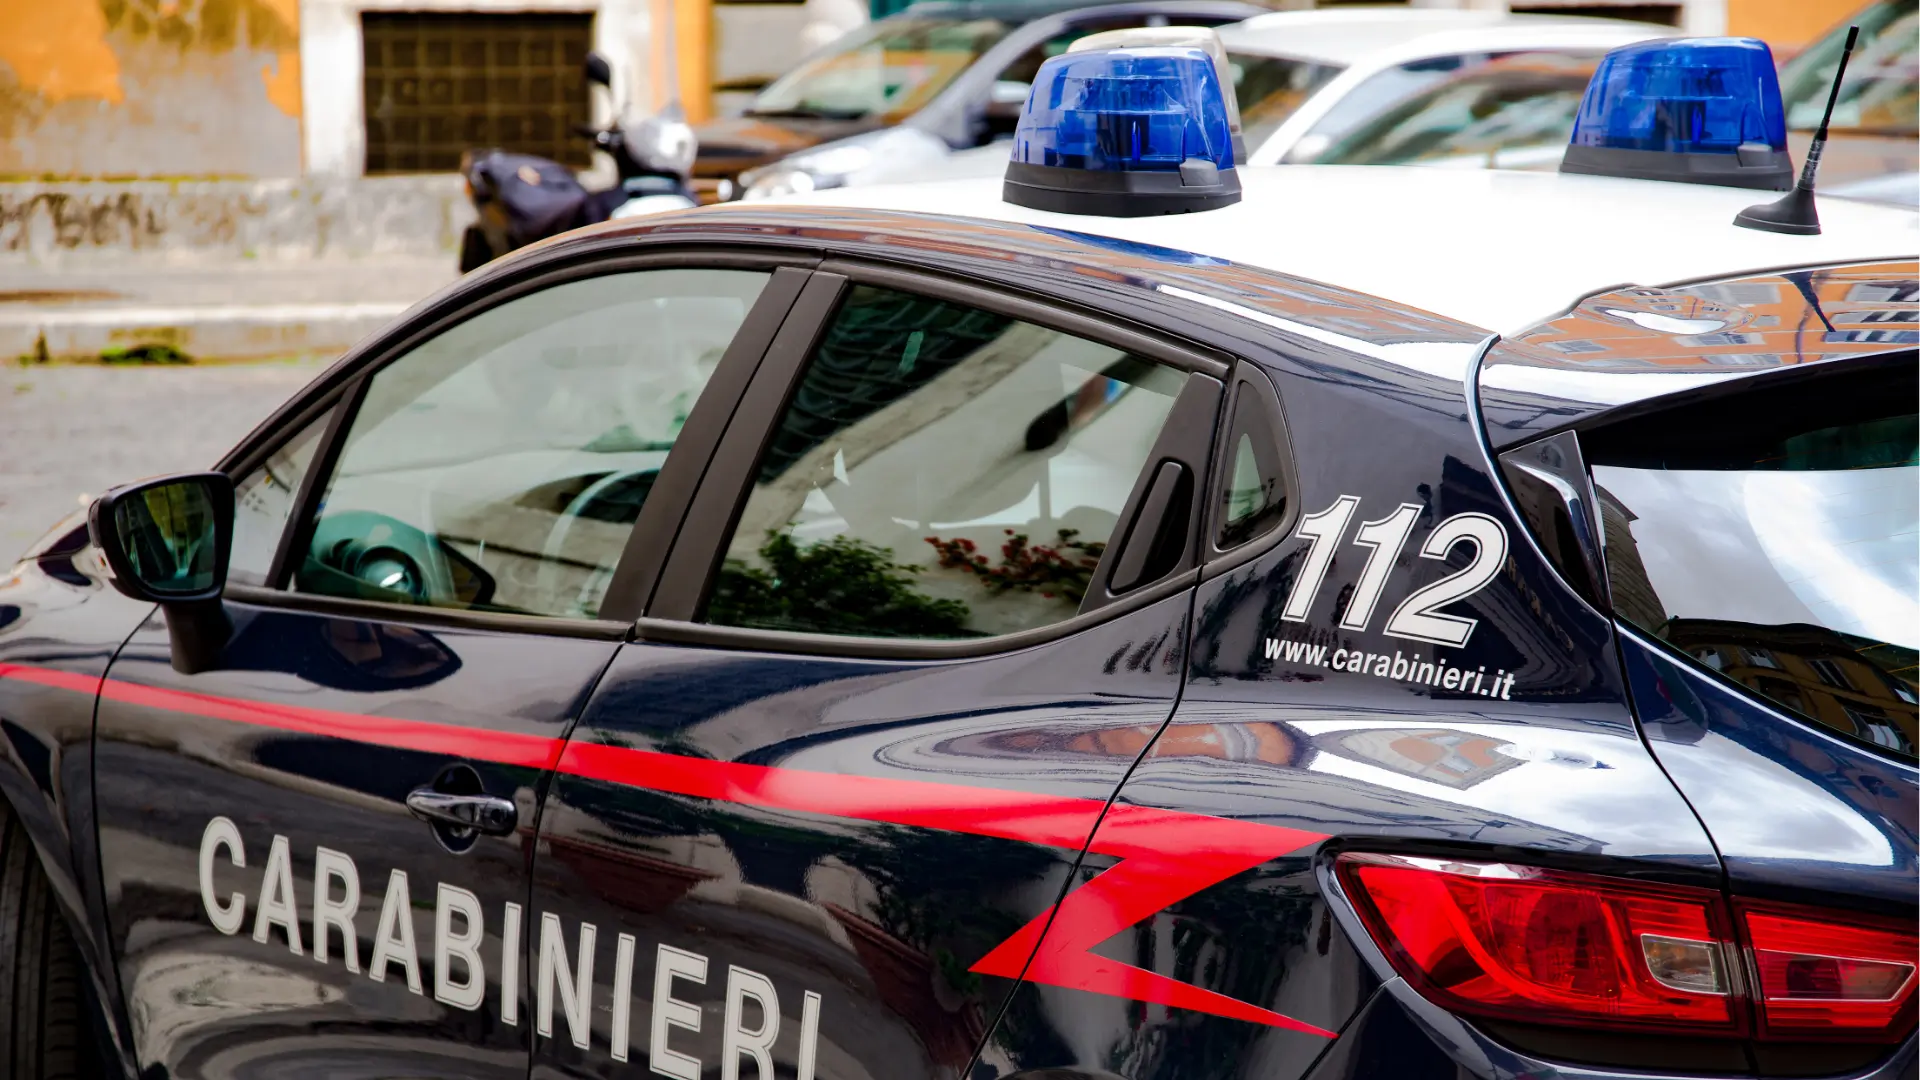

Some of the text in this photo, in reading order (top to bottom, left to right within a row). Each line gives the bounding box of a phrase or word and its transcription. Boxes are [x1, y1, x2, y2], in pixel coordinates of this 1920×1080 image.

[1281, 494, 1509, 649] 112
[1264, 637, 1516, 701] www.carabinieri.it
[199, 815, 822, 1080] CARABINIERI
